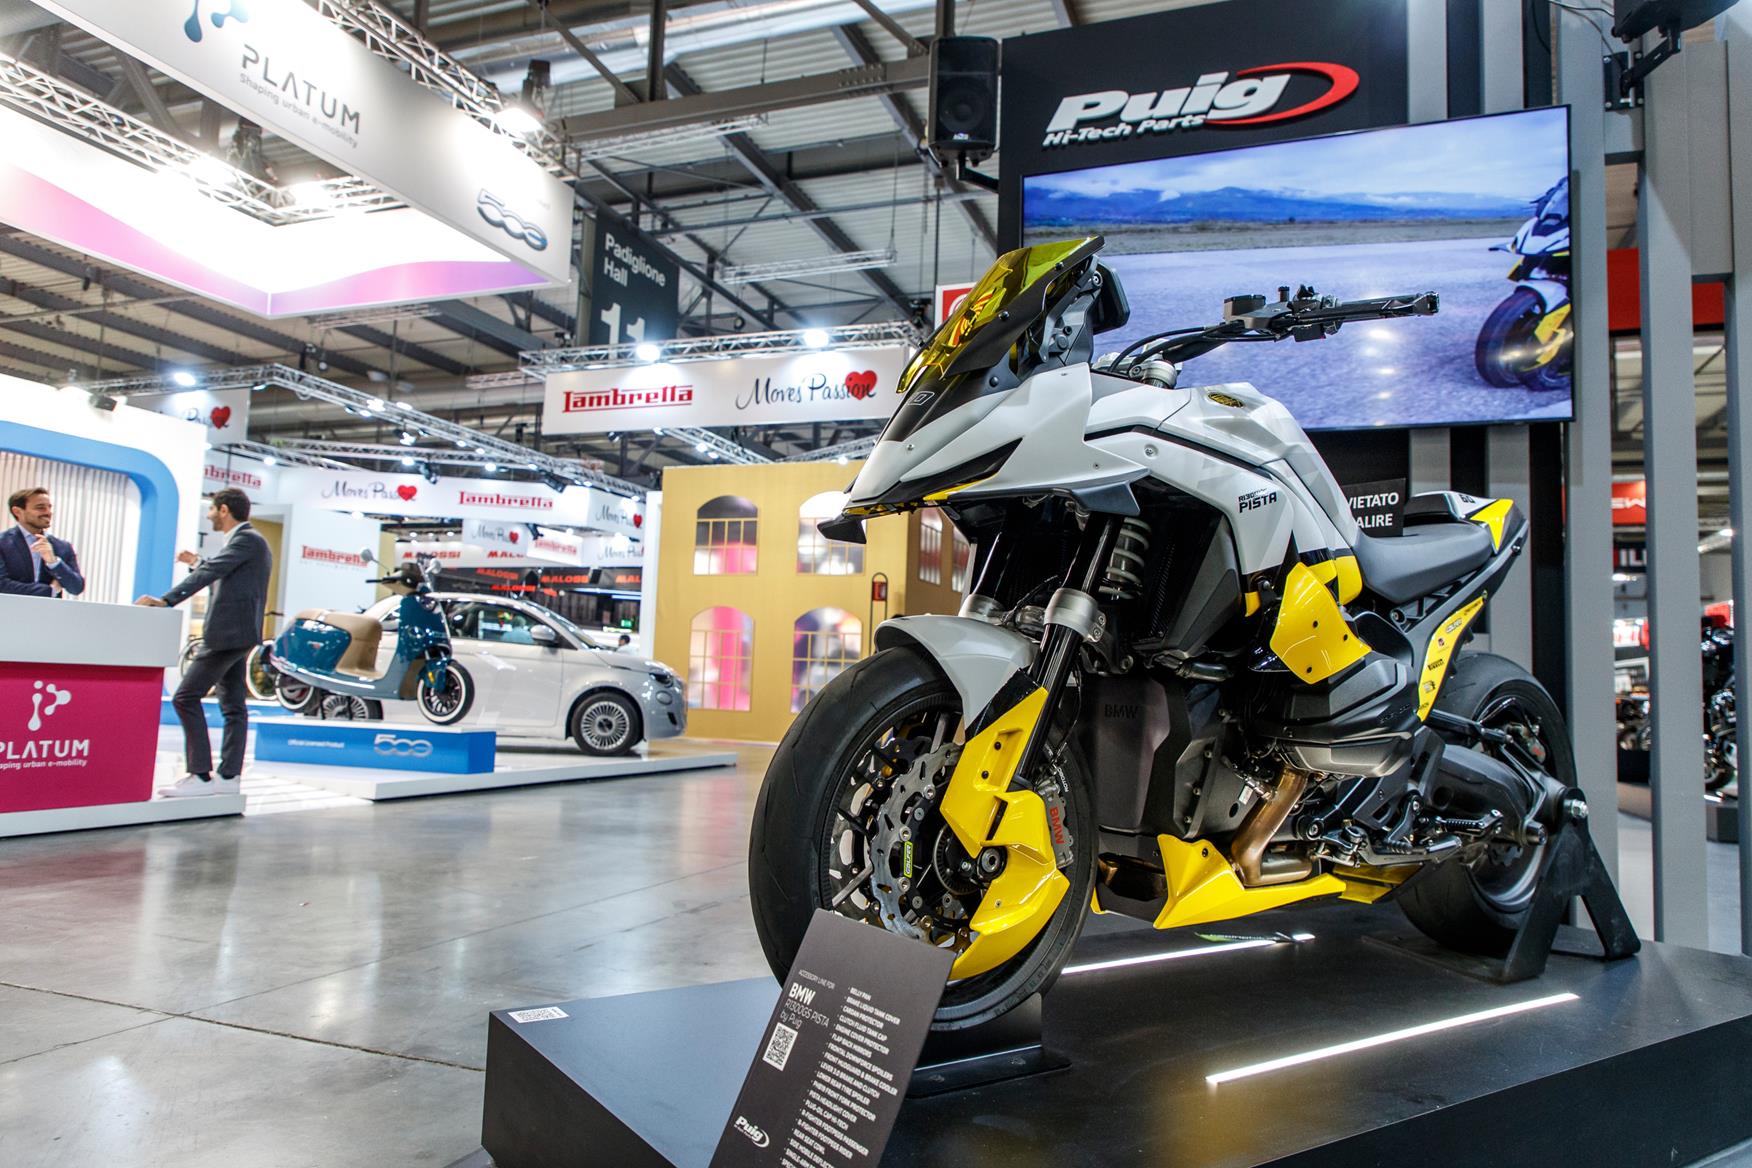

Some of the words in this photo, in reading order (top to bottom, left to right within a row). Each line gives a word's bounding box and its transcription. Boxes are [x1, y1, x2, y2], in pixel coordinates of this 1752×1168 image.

[240, 72, 280, 105] Shaping
[242, 43, 361, 135] PLATUM
[1046, 71, 1292, 132] Puig
[1042, 122, 1133, 146] Hi-Tech
[1136, 113, 1207, 134] Parts
[603, 256, 629, 288] Hall
[604, 231, 667, 288] Padiglione
[1239, 491, 1277, 514] PISTA
[1357, 513, 1393, 529] ALIRE
[1104, 703, 1138, 719] BMW
[1049, 806, 1065, 845] BMW
[789, 982, 816, 1005] BMW
[780, 1010, 788, 1023] by
[789, 1012, 803, 1030] Puig
[811, 1011, 829, 1028] PISTA
[877, 1033, 887, 1041] CAP
[735, 1115, 764, 1142] Puig
